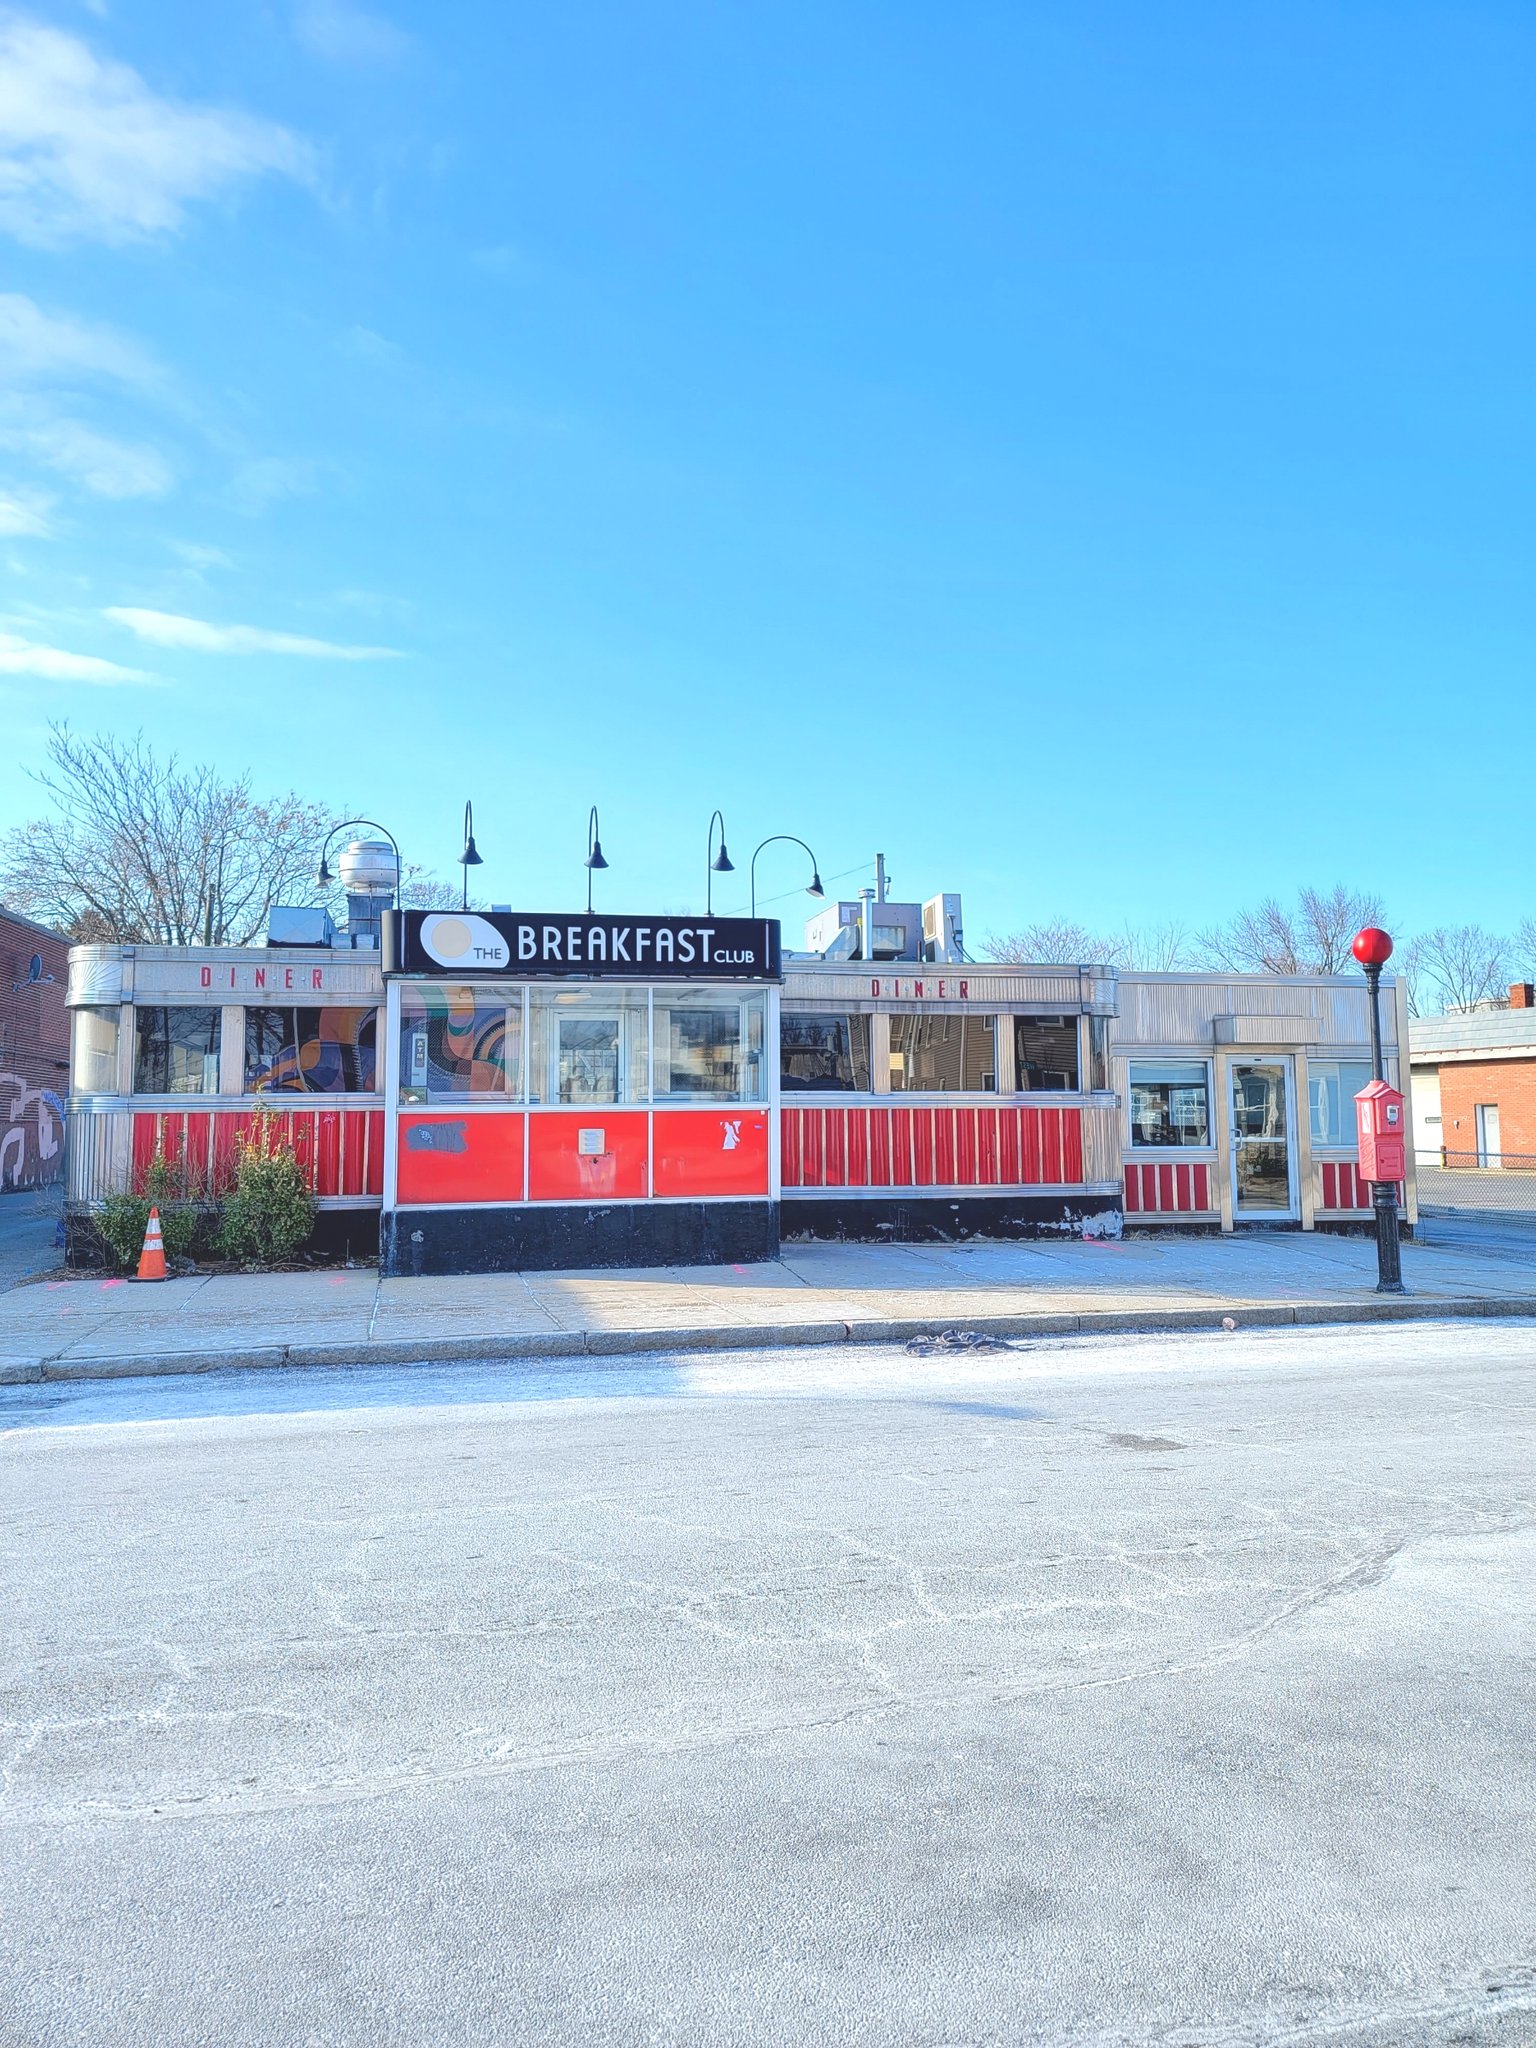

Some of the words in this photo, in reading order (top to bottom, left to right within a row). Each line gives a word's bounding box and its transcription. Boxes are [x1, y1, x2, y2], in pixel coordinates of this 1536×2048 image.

[473, 947, 502, 960] THE
[518, 925, 715, 963] BREAKFAST
[714, 950, 755, 964] CLUB
[201, 966, 323, 989] DINER
[871, 979, 968, 998] DINER
[416, 1039, 424, 1059] ATM
